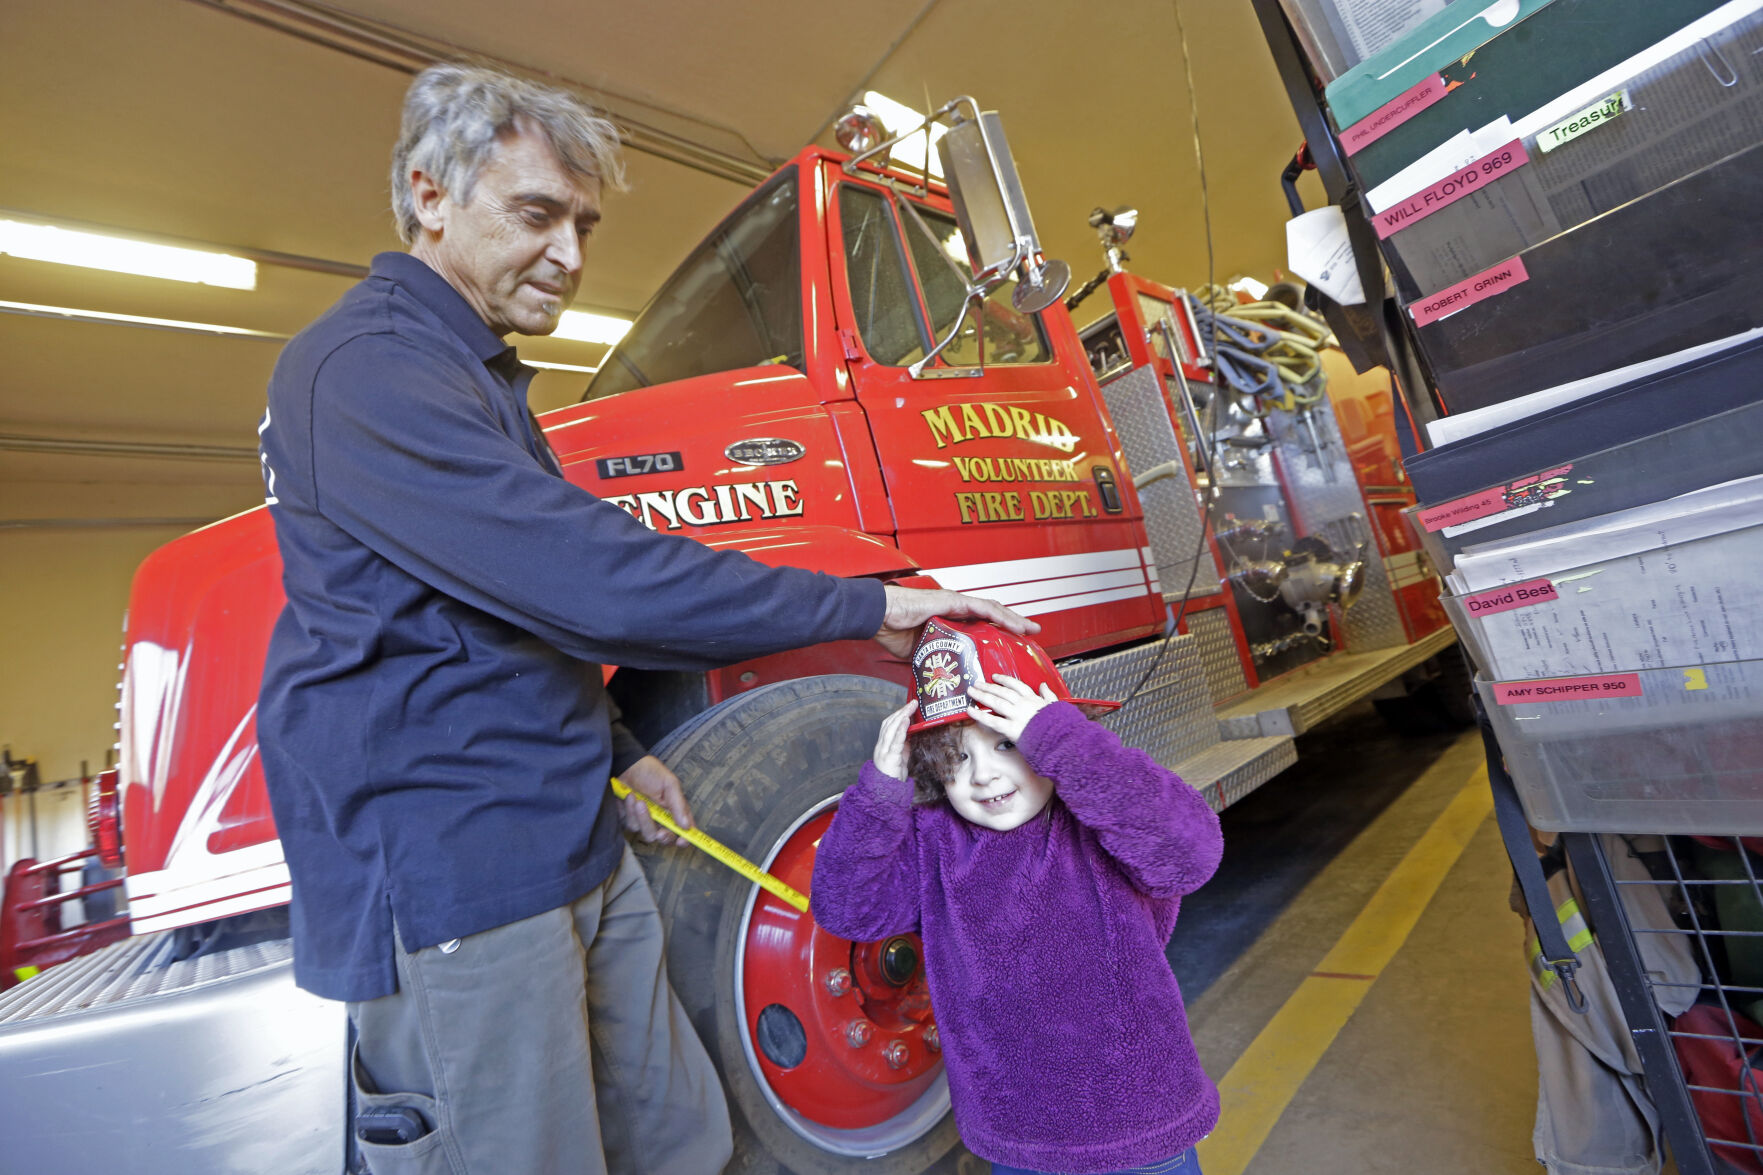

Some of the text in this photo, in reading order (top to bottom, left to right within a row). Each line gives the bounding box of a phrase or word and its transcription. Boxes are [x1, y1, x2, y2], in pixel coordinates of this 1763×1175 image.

[1351, 129, 1370, 142] PHIL
[1384, 203, 1422, 226] WILL
[1423, 170, 1479, 206] FLOYD
[1481, 151, 1513, 175] 969
[1423, 270, 1512, 315] ROBERT GRINN
[921, 403, 1076, 453] MADRID
[606, 454, 675, 476] FL70
[952, 456, 1081, 482] VOLUNTEER
[955, 490, 1098, 524] FIRE DEPT.
[1468, 583, 1555, 612] David Best
[915, 645, 929, 664] SANTA
[935, 640, 960, 650] COUNTY
[1507, 681, 1627, 697] AMY SCHIPPER 950
[926, 697, 965, 714] FIRE DEPARTMENT
